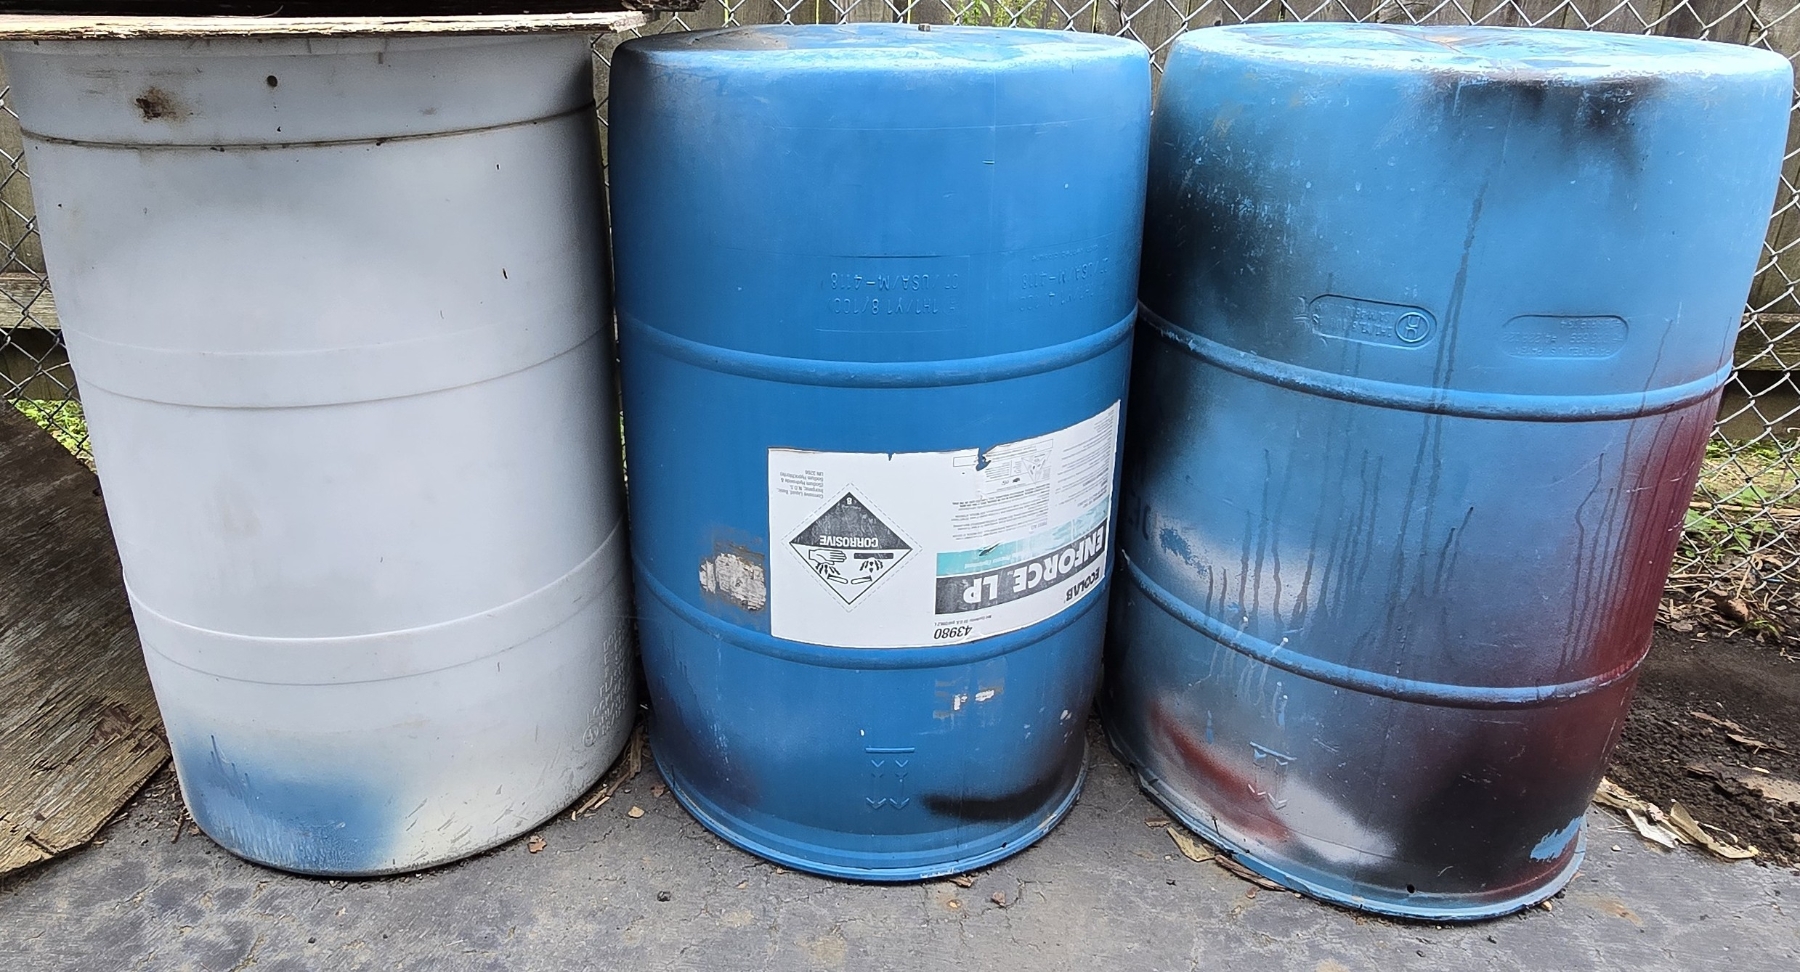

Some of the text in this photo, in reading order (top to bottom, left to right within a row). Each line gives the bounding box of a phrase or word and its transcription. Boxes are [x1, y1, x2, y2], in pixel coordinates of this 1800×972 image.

[819, 534, 879, 548] CORROSIVE
[1012, 526, 1104, 592] ENFORCE
[962, 575, 999, 603] LP
[1065, 567, 1101, 602] ECOLAB
[933, 625, 972, 639] 43980
